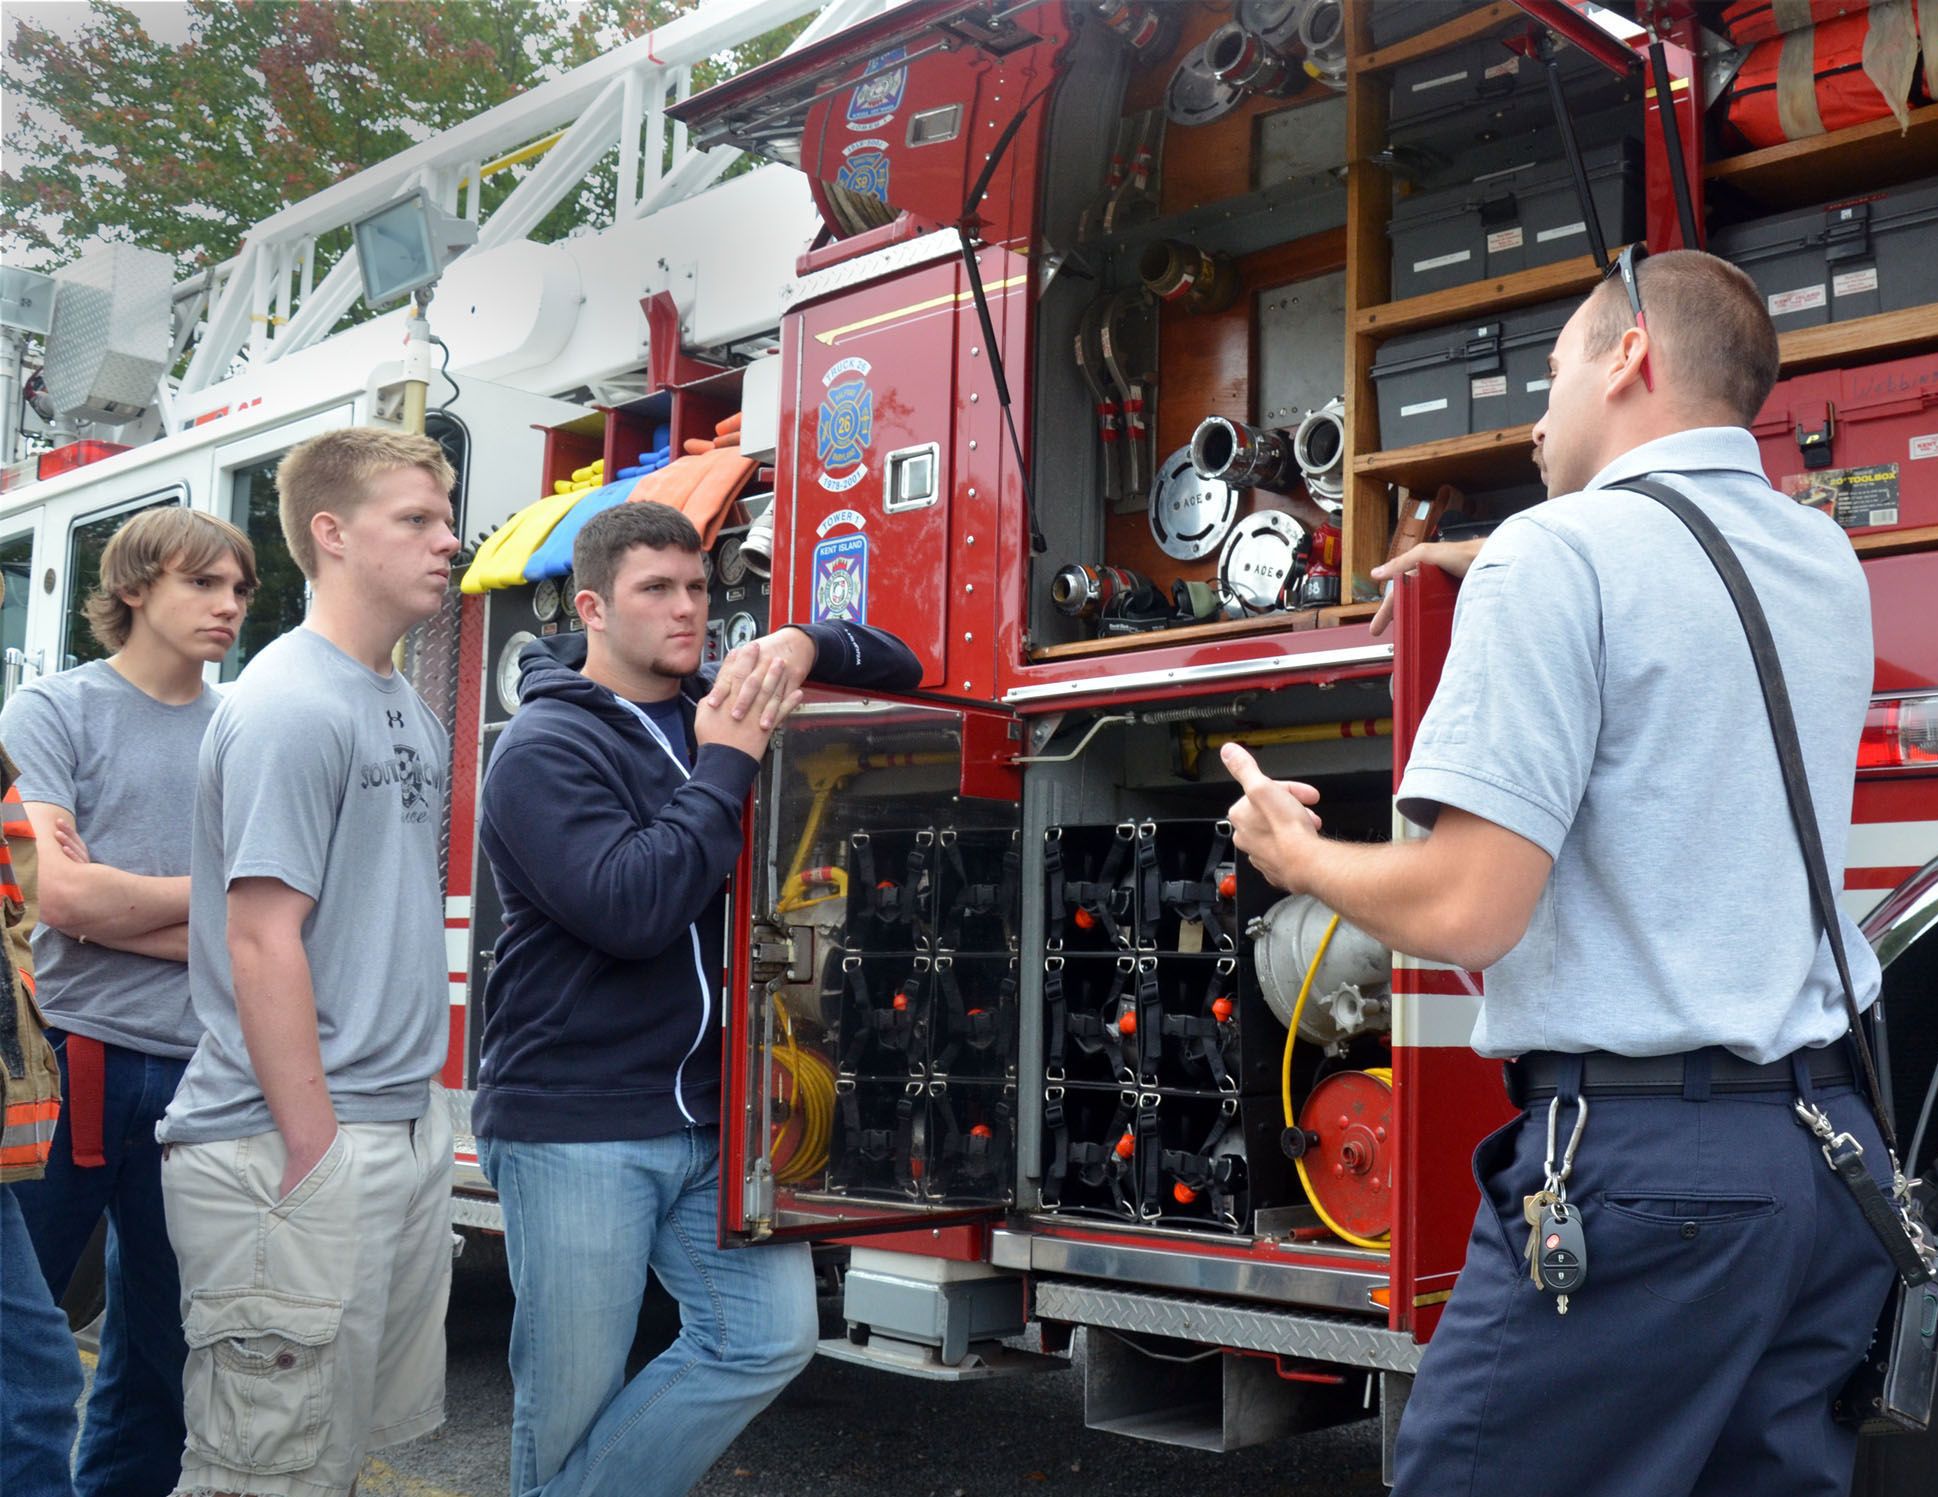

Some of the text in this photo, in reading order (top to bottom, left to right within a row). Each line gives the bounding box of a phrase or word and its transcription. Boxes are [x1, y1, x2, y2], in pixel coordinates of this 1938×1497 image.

[825, 360, 854, 381] TRUCK
[838, 415, 851, 434] 26
[823, 471, 861, 490] 1978-2001
[1848, 472, 1896, 484] TOOLBOX
[822, 511, 852, 531] TOWER
[820, 540, 863, 556] KENT ISLAND
